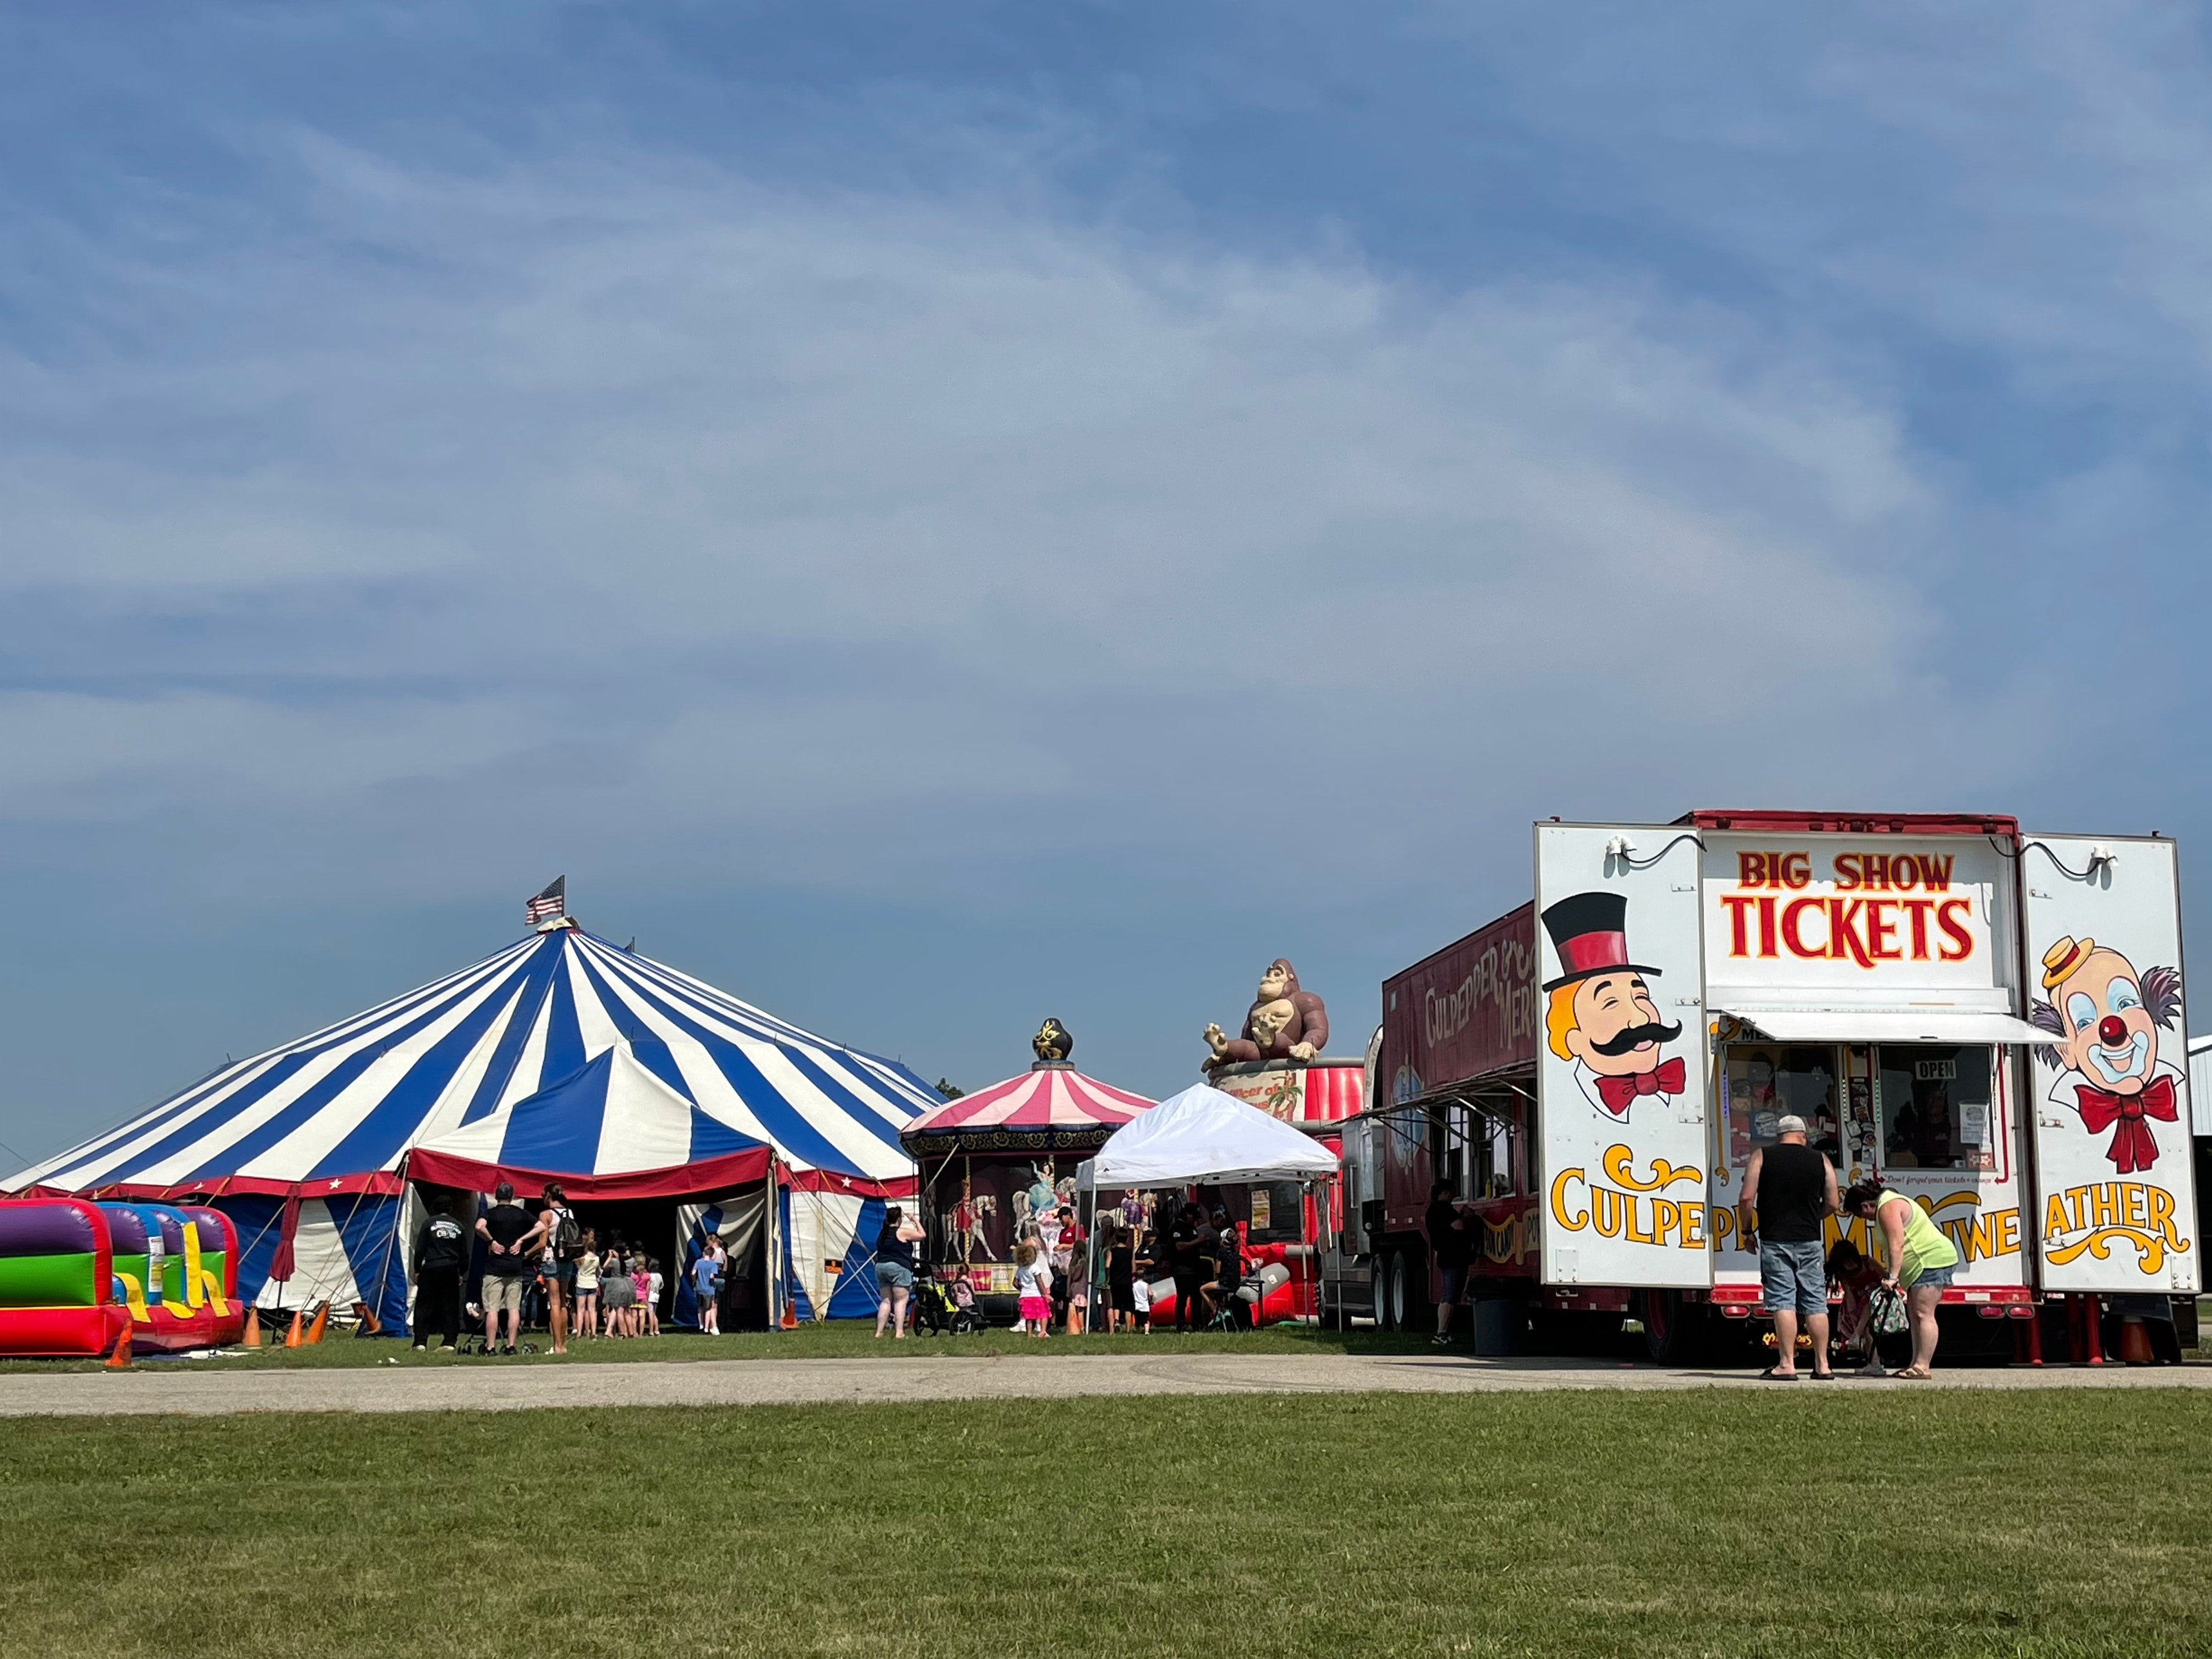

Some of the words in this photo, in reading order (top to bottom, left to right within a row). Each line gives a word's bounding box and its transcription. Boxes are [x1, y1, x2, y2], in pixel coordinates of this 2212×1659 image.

[1736, 851, 1812, 891] BIG
[1833, 851, 1955, 893] SHOW
[1720, 895, 1974, 969] TICKETS
[1426, 947, 1499, 1048] CULPEPPER
[1920, 1062, 1954, 1077] OPEN
